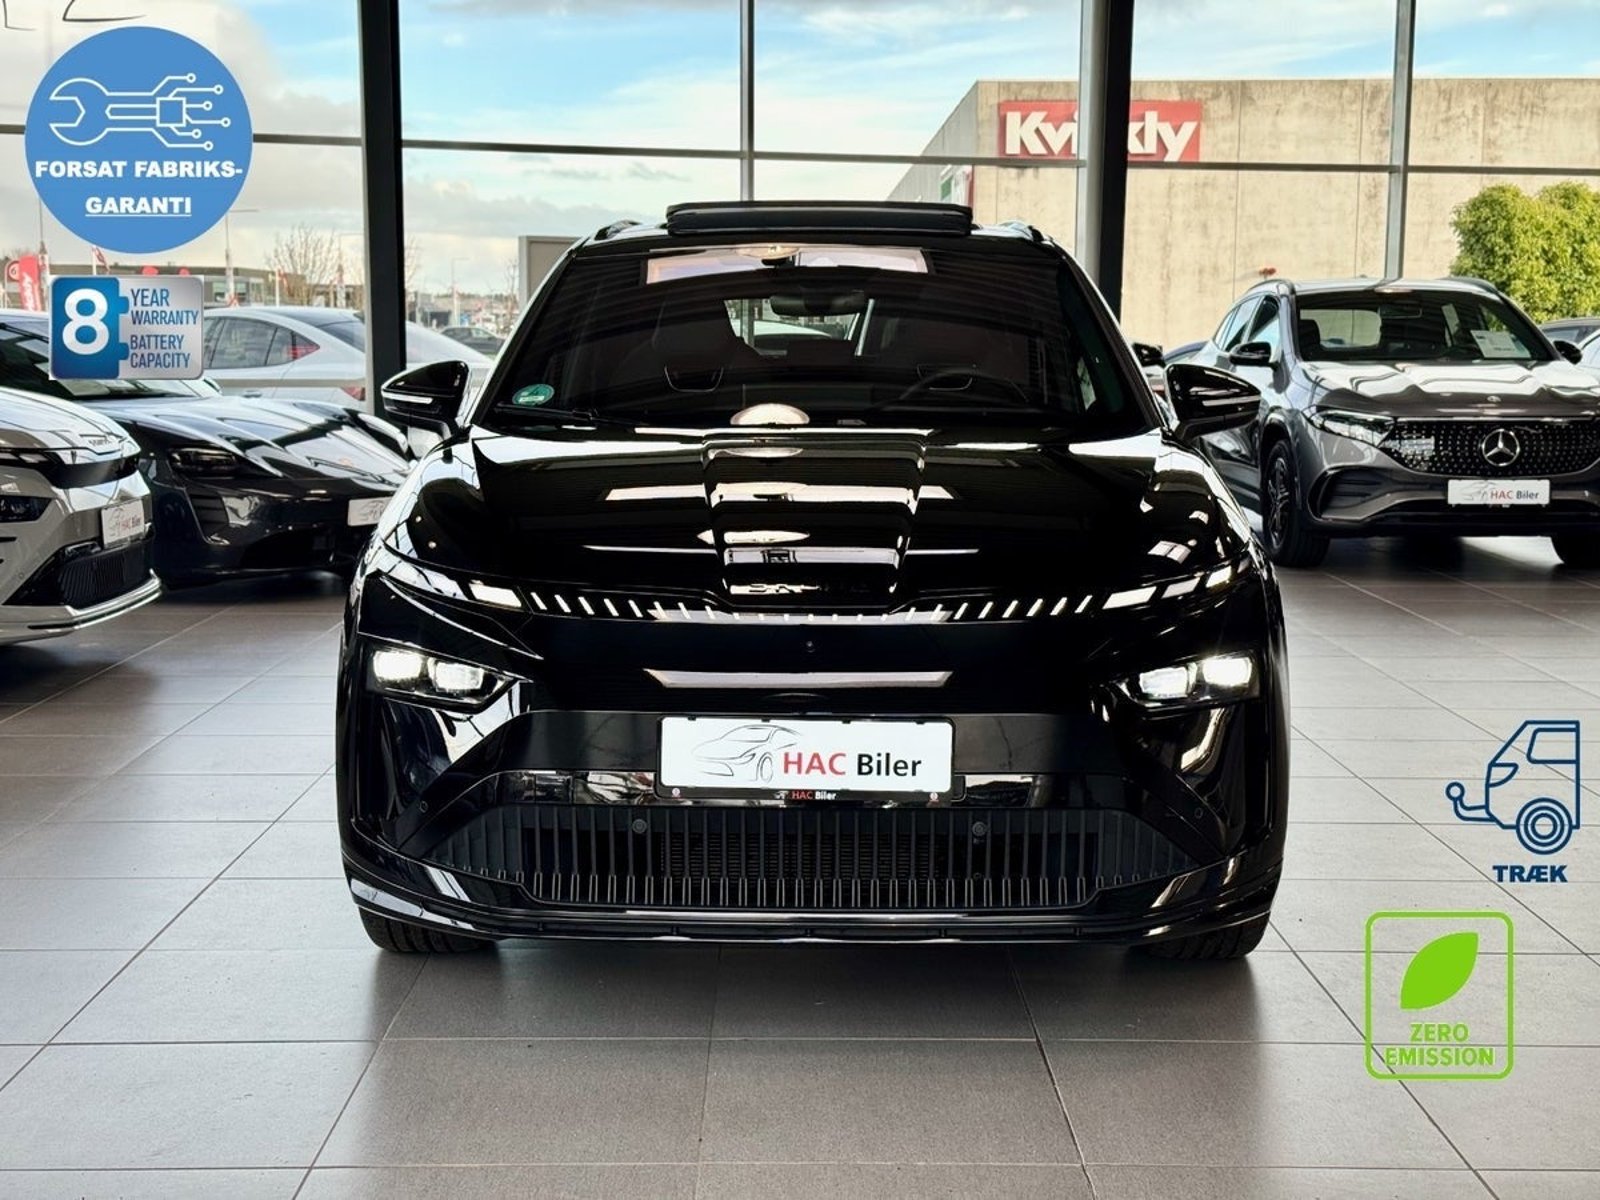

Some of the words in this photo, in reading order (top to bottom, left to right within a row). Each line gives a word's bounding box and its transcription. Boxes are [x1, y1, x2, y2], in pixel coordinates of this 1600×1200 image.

[1490, 490, 1514, 499] HAC
[1516, 490, 1539, 499] Biler
[783, 752, 847, 775] HAC
[856, 752, 922, 777] Biler
[791, 790, 813, 800] HAC
[815, 791, 837, 800] Biler
